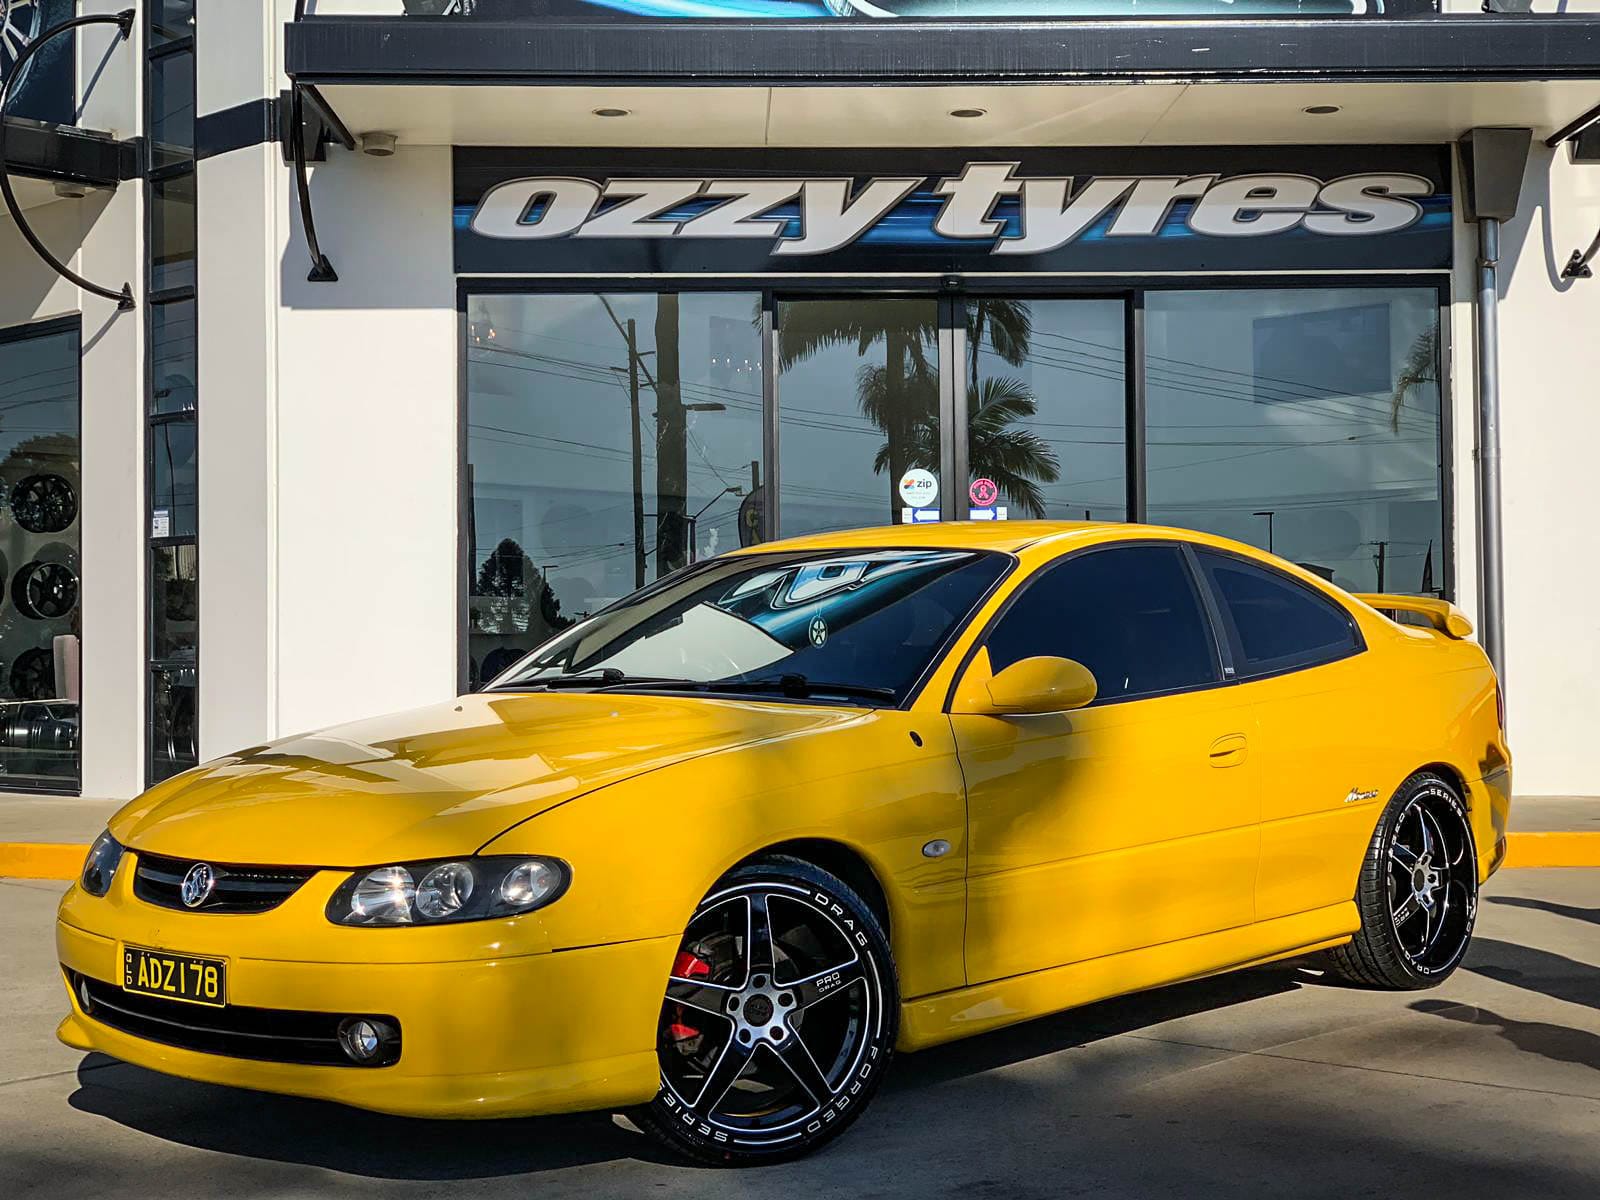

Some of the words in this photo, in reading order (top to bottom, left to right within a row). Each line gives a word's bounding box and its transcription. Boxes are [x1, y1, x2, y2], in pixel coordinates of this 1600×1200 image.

[469, 175, 926, 256] ozzy
[931, 160, 1435, 256] tyres
[916, 478, 932, 489] zip
[814, 892, 868, 947] DRAG
[125, 953, 133, 985] QLD
[138, 955, 218, 999] ADZ178
[816, 971, 840, 988] PRO
[818, 979, 842, 994] DRAG
[806, 1045, 878, 1134] FORGED
